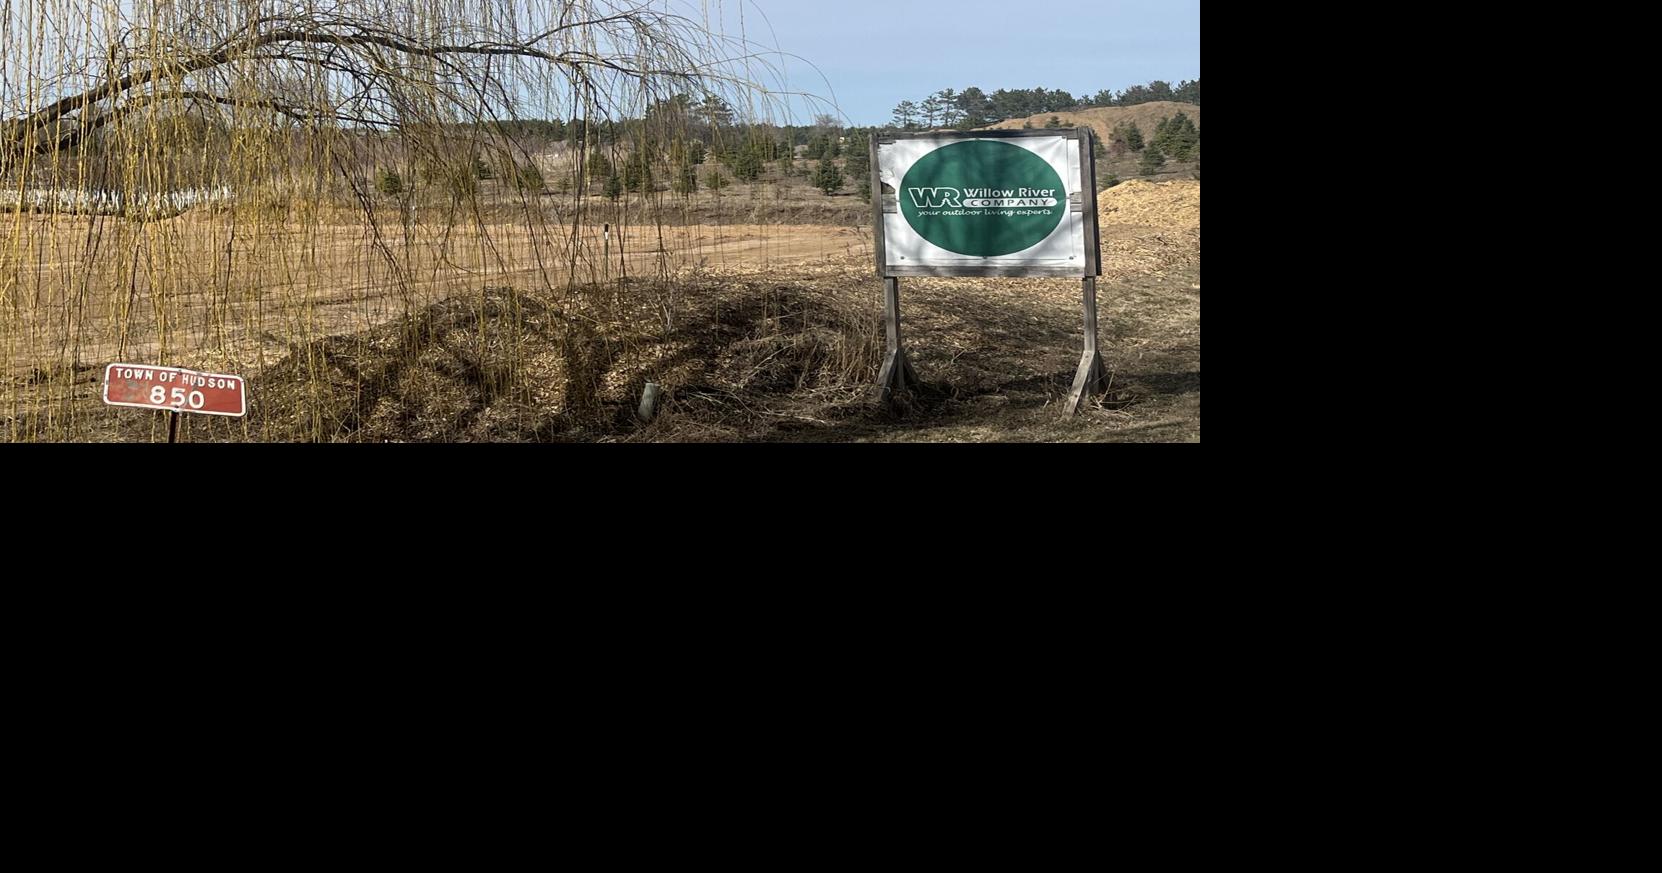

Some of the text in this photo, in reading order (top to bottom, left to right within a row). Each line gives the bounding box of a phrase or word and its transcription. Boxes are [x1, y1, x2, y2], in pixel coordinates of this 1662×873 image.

[963, 188, 1015, 197] Willow
[1018, 187, 1055, 197] River
[971, 198, 1050, 206] COMPANY
[918, 208, 1052, 217] your outdoor living experts
[116, 368, 235, 390] TOWN OF HUDSON
[149, 385, 205, 409] 850
